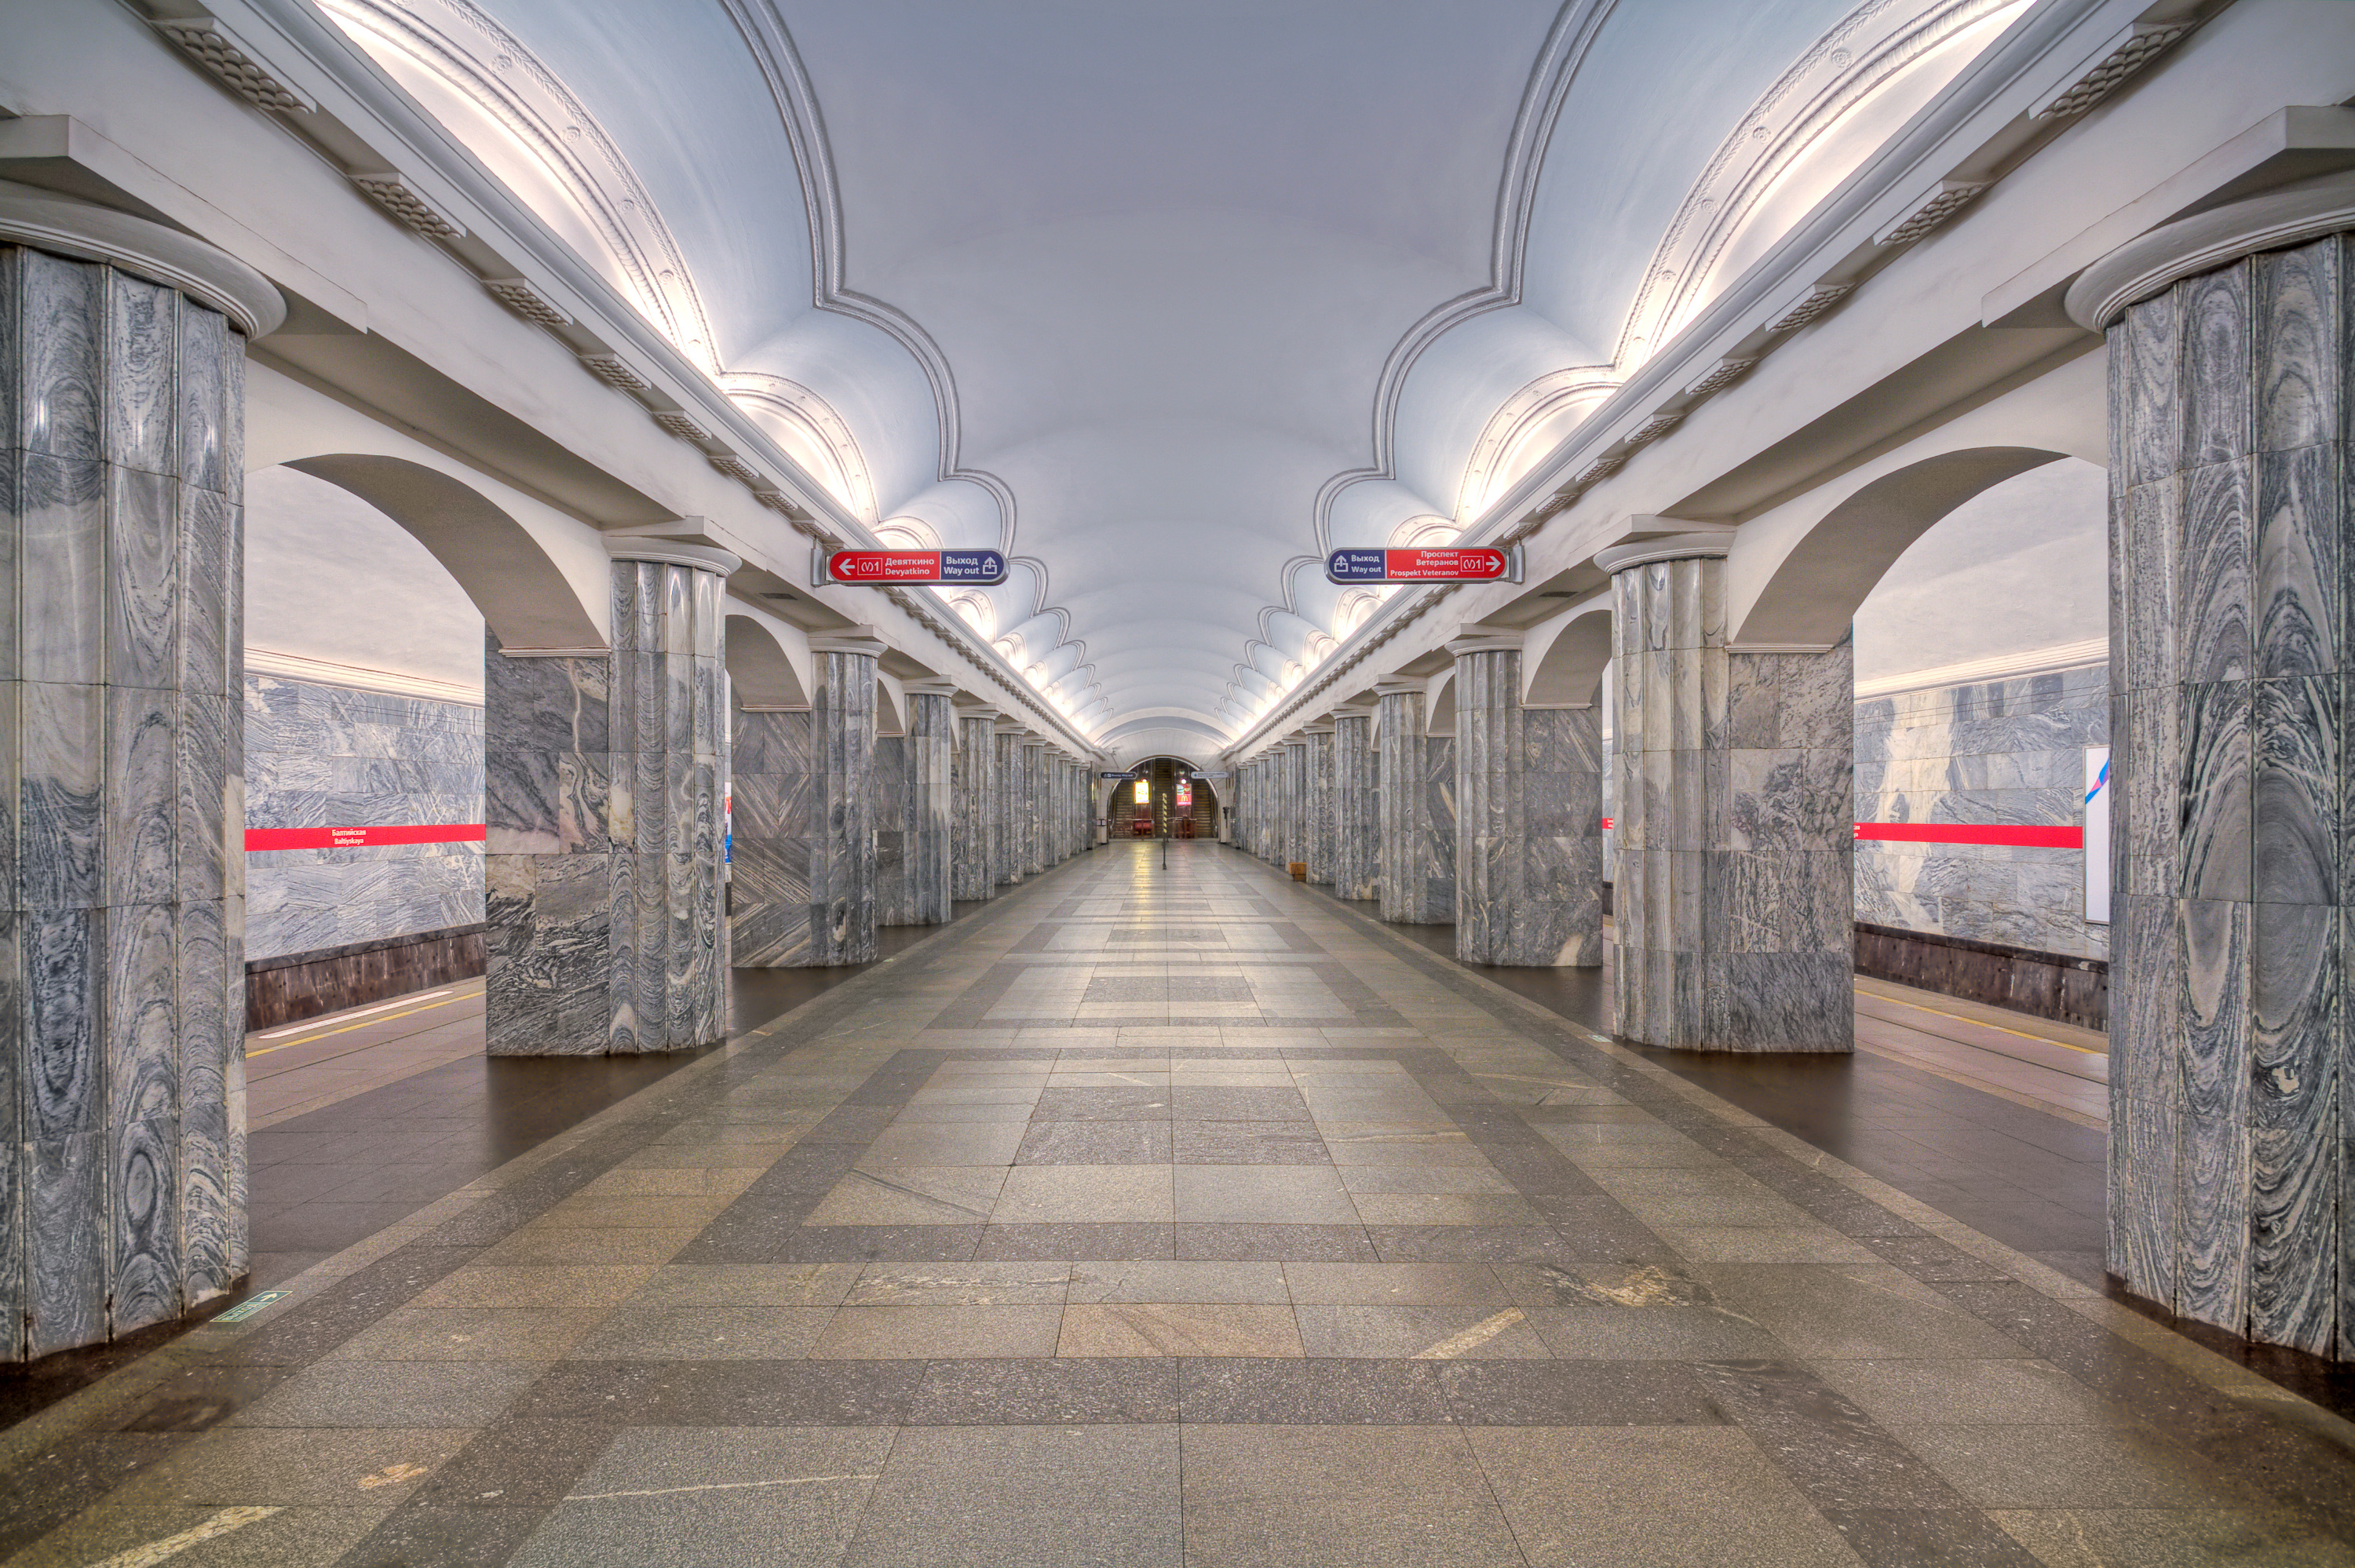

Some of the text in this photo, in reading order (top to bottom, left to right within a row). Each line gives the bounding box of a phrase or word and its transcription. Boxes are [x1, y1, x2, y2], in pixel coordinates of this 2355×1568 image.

[885, 557, 934, 567] Девяткино
[946, 556, 978, 566] Выход
[1351, 554, 1380, 563] Выход
[885, 567, 929, 577] Devyatkino
[943, 567, 962, 576] Way
